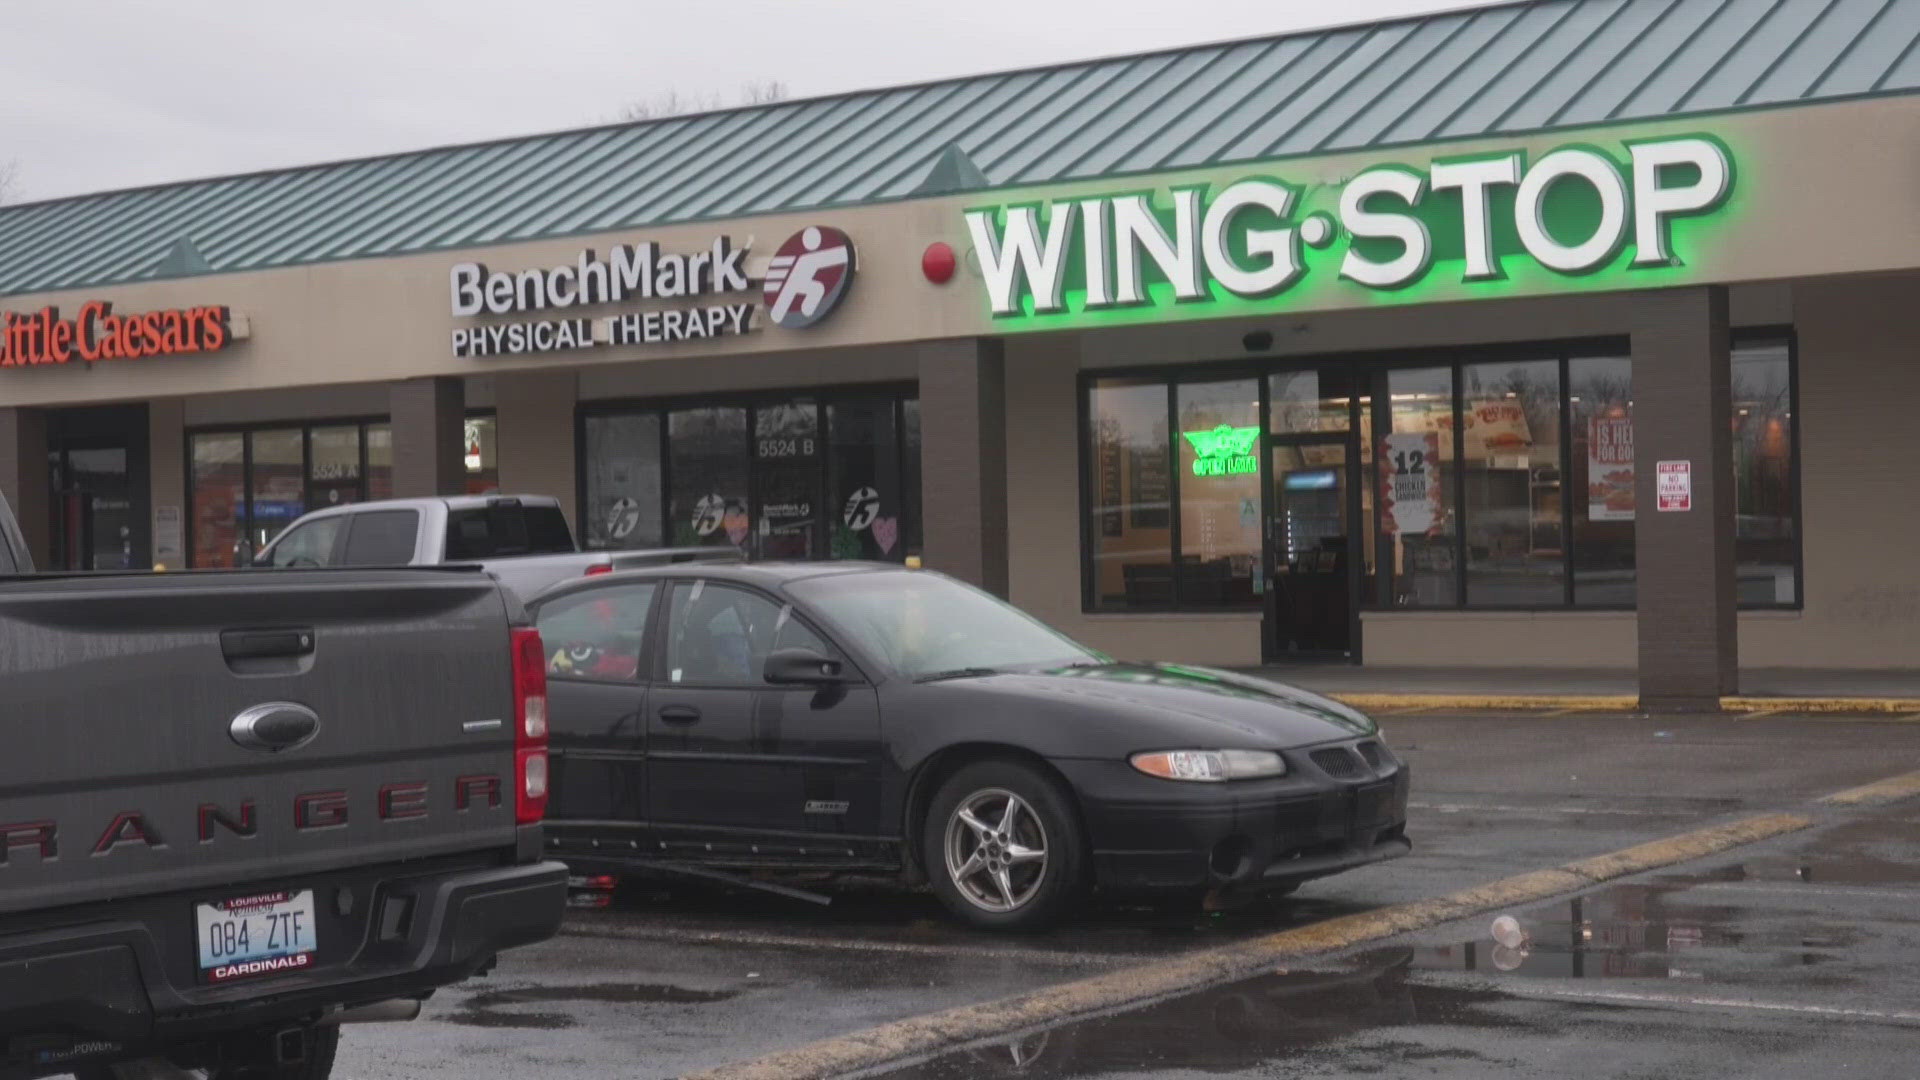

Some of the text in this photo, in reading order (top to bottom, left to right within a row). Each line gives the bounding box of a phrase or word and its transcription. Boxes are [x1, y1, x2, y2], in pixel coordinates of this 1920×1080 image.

[450, 235, 748, 317] BenchMark
[0, 299, 223, 366] ittle Caesars
[452, 303, 748, 357] PHYSICAL THERAPY
[760, 439, 814, 457] 5524 B
[1193, 455, 1257, 476] OPEN LATE
[1395, 450, 1425, 474] 12
[1660, 484, 1687, 492] PARKING
[1668, 474, 1679, 482] NO
[0, 775, 502, 867] RANGER
[230, 893, 284, 908] LOUISVILLE
[210, 911, 305, 958] 084 ZTF
[215, 954, 308, 979] CARDINALS
